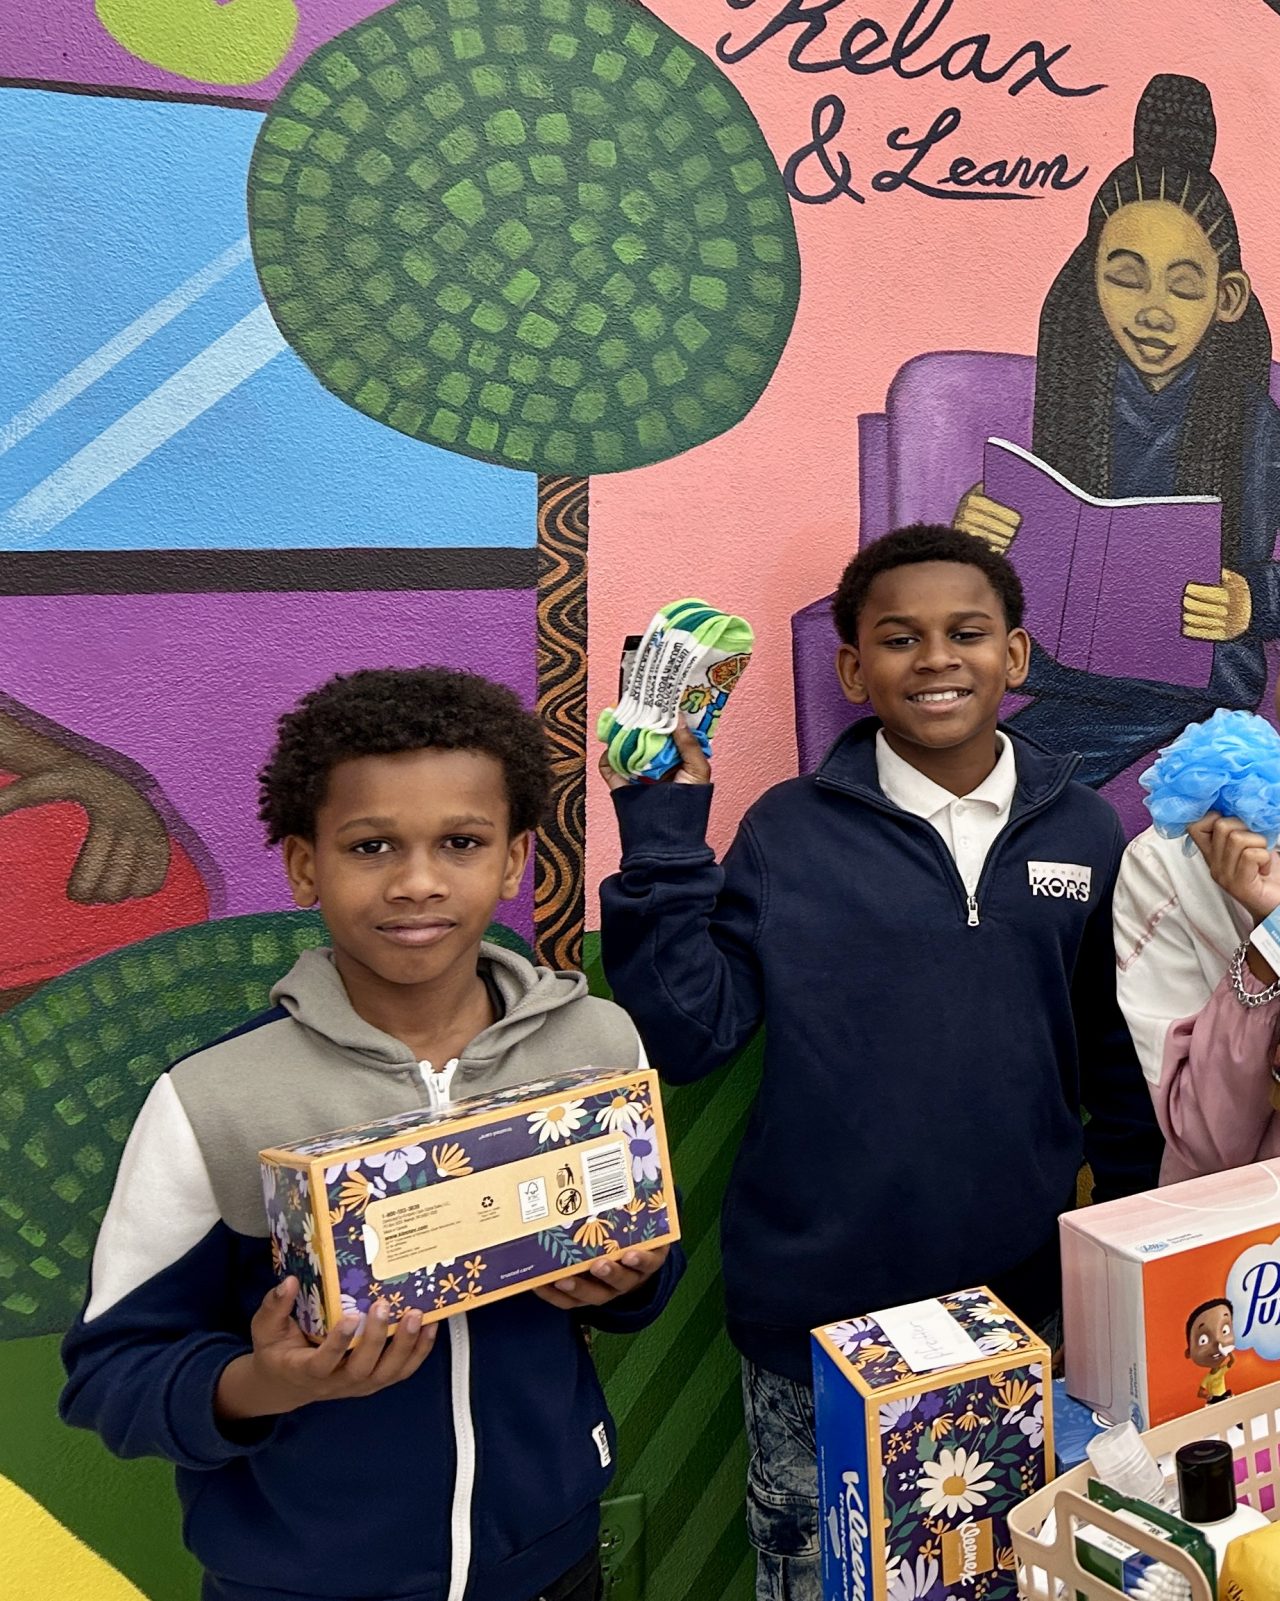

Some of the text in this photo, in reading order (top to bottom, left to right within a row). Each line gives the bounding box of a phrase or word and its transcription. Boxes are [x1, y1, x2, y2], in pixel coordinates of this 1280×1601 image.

[783, 94, 1089, 204] & Learn
[1032, 876, 1090, 902] KORS
[955, 1515, 981, 1588] Kleenex
